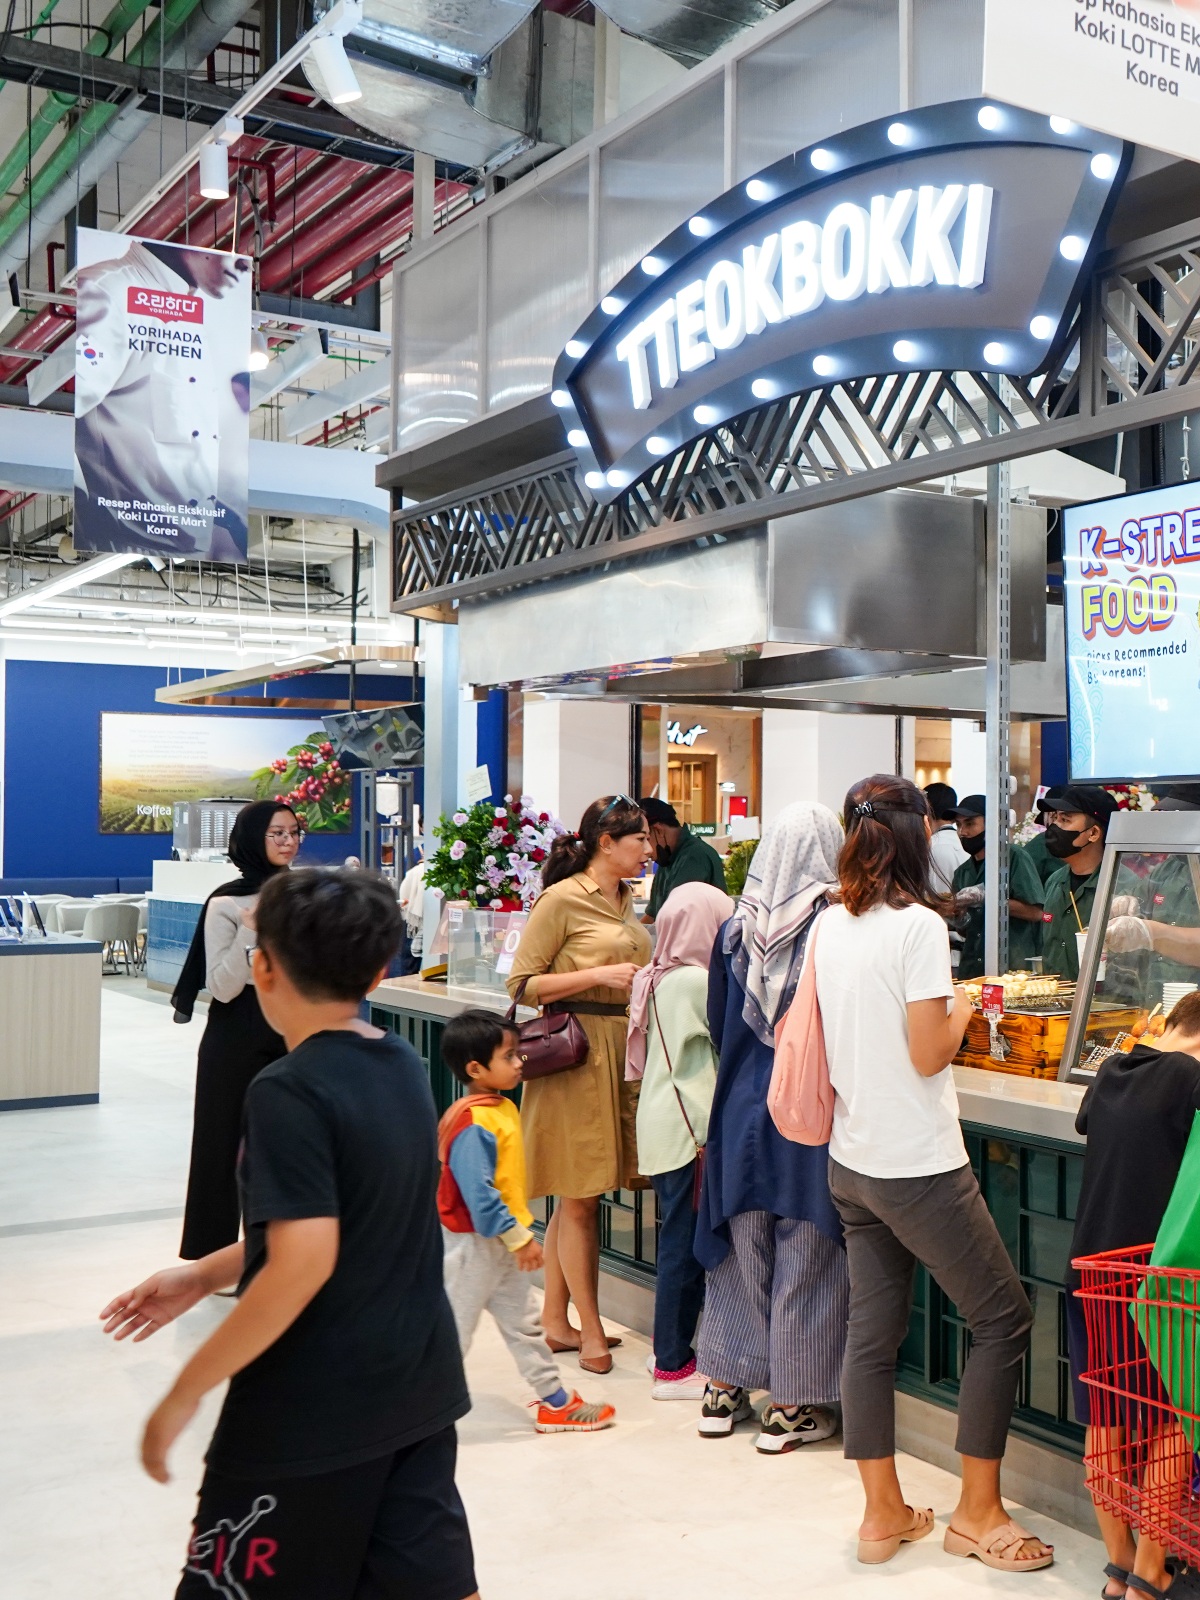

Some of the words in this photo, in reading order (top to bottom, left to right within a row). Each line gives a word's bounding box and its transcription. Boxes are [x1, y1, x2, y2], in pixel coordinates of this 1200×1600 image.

[1102, 0, 1176, 38] Rahasia
[1074, 12, 1116, 44] Koki
[1121, 29, 1181, 68] LOTTE
[1126, 60, 1179, 97] Korea
[134, 292, 198, 313] 요리하다
[616, 183, 994, 410] TTEOKBOKKI
[149, 307, 183, 317] YORIHADA
[128, 323, 202, 344] YORIHADA
[128, 338, 202, 360] KITCHEN
[97, 496, 131, 510] Resep
[132, 499, 176, 513] Rahasia
[178, 504, 226, 518] Eksklusif
[117, 510, 142, 521] Koki
[143, 513, 179, 525] LOTTE
[180, 517, 207, 528] Mart
[146, 525, 178, 536] Korea
[1081, 573, 1178, 641] FOOD
[1114, 640, 1187, 662] Recommended
[137, 804, 172, 818] Koffea
